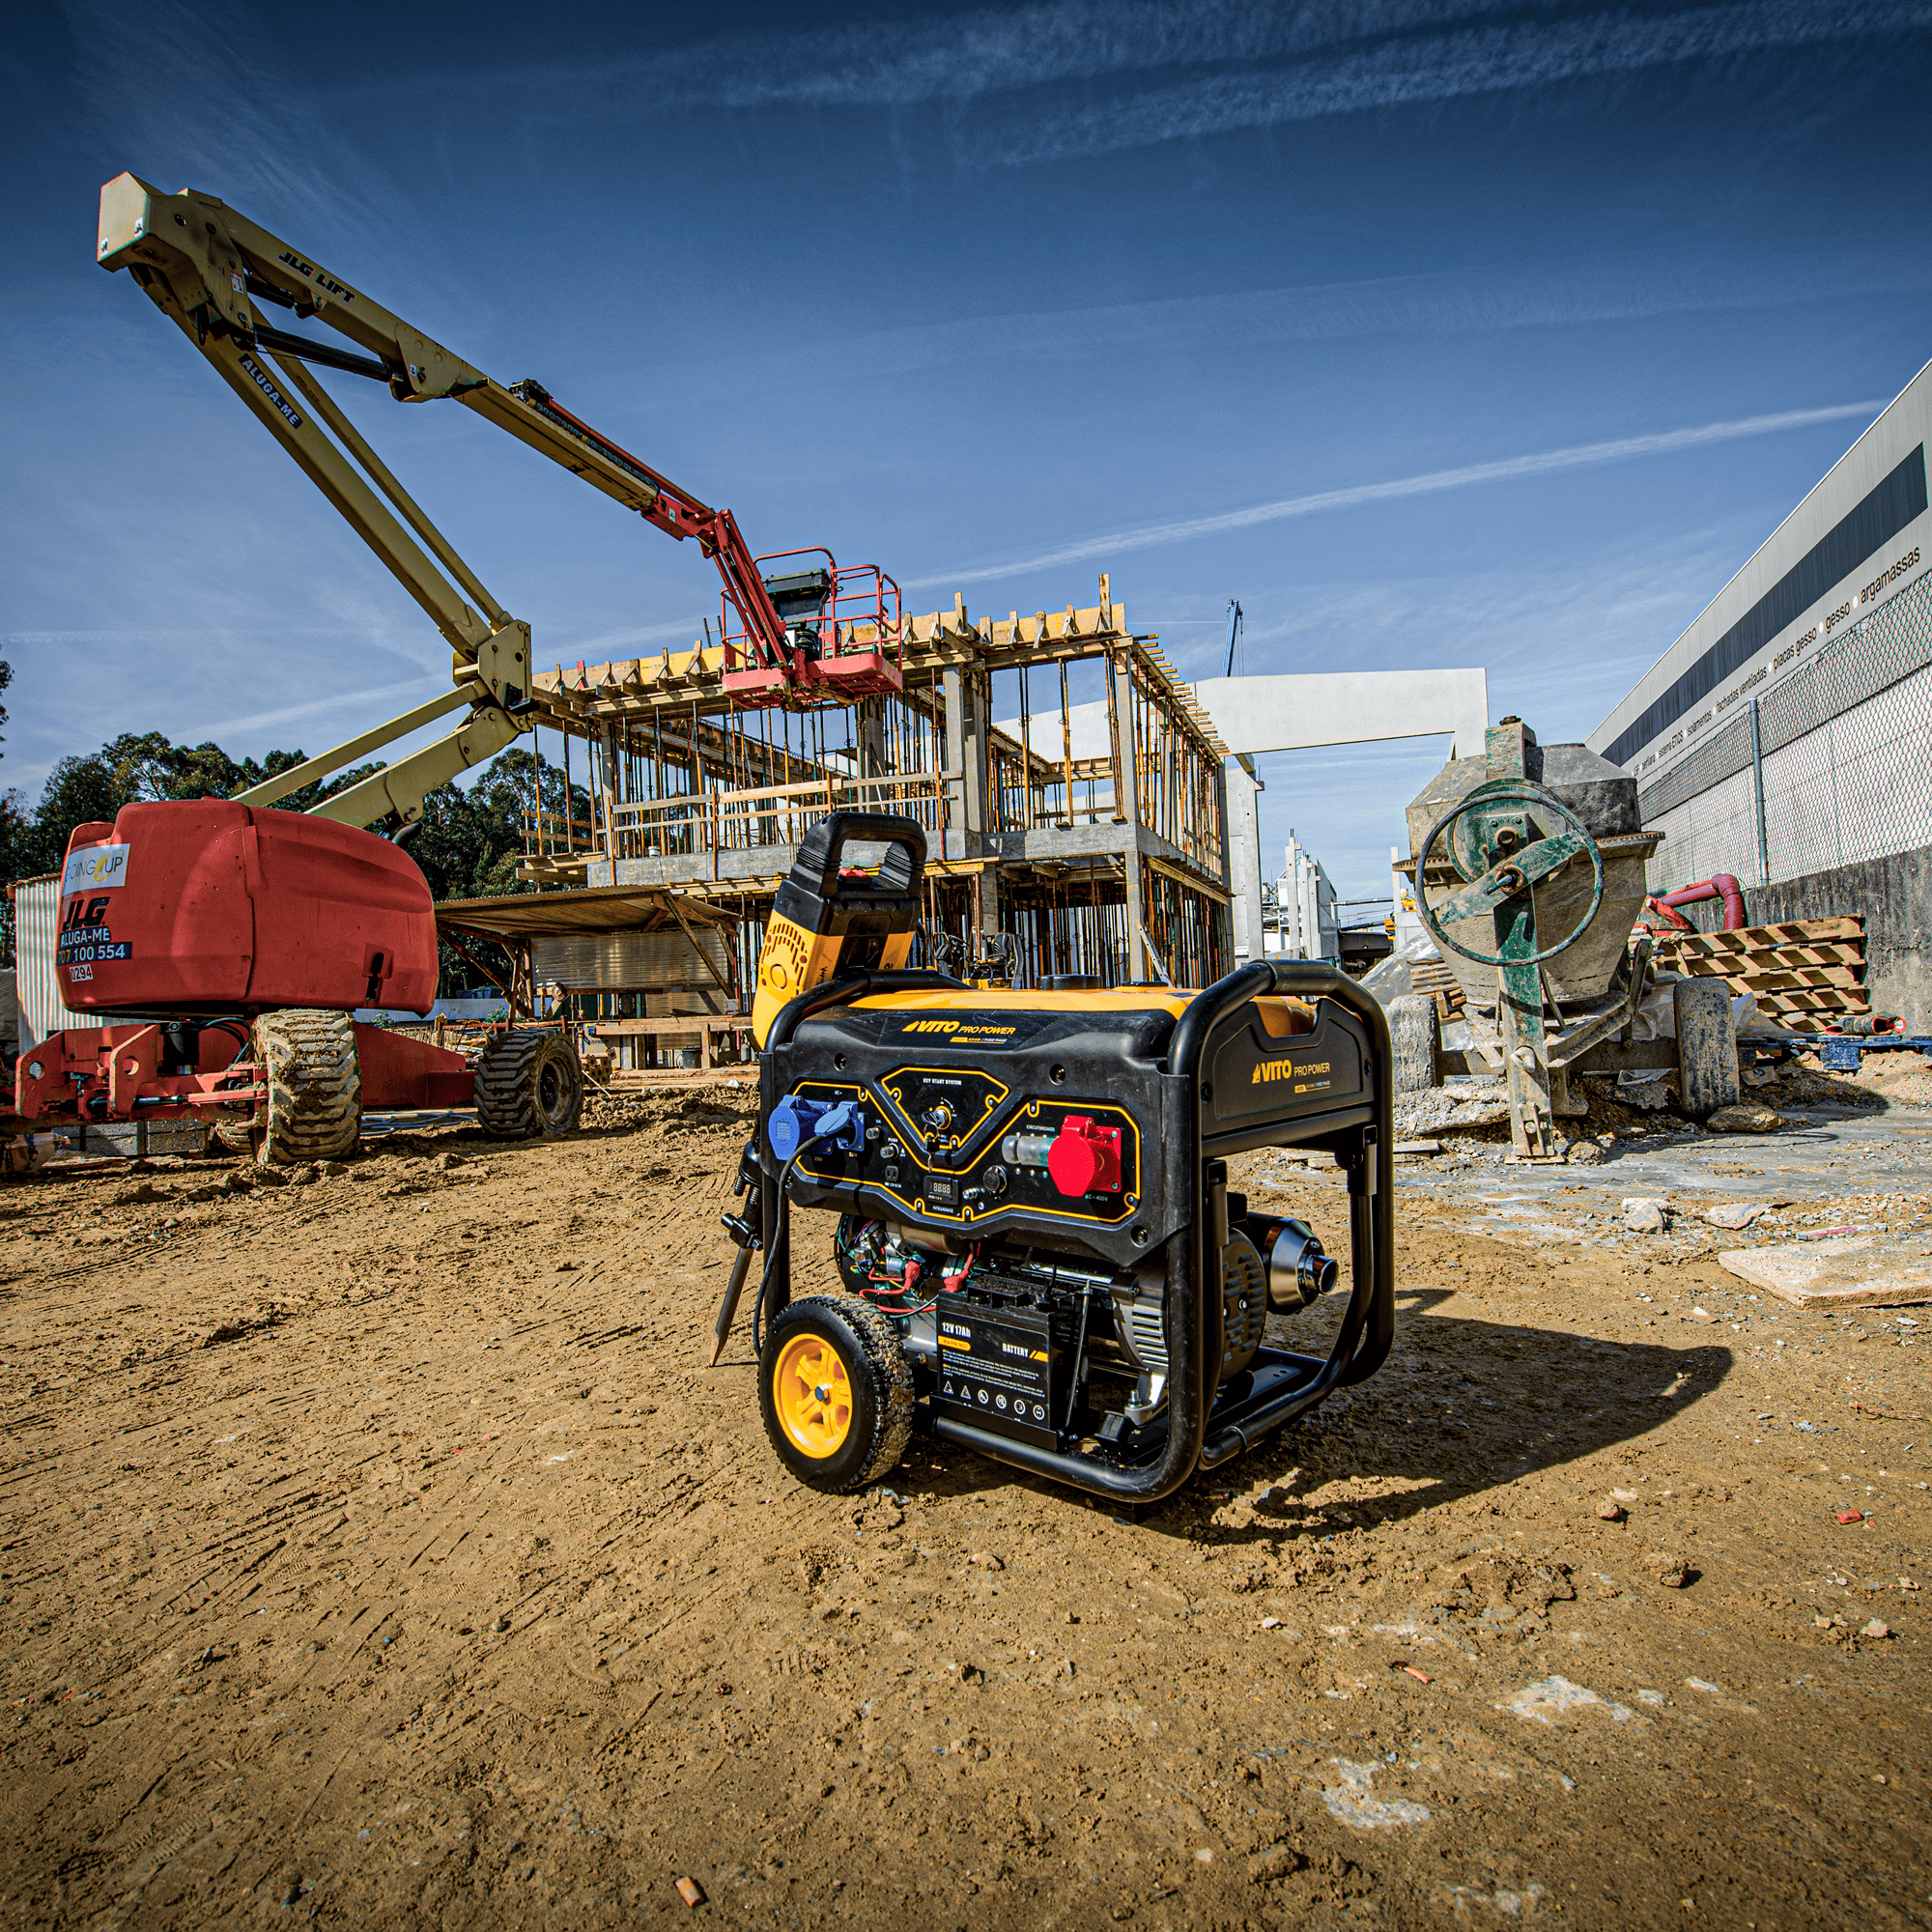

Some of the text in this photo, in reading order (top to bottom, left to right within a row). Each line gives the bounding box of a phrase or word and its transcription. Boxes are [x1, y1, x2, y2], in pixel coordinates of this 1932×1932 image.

[277, 251, 355, 303] JLG LIFT
[242, 359, 299, 425] ALUGA-ME
[1716, 689, 1739, 714] fachadas
[1739, 667, 1767, 696] ventiladas
[1773, 645, 1795, 674] placas
[1795, 628, 1817, 657] gesso
[1825, 602, 1850, 634] gesso
[1861, 547, 1920, 604] argamassas
[104, 856, 123, 873] UP
[62, 896, 111, 931] JLG
[60, 927, 110, 949] ALUGA-ME
[73, 946, 95, 962] 100
[98, 944, 126, 960] 554
[70, 967, 93, 981] 0294
[916, 1020, 960, 1033] VITO
[979, 1026, 1016, 1035] POWER
[1261, 1059, 1330, 1082] VITO PRO POWER
[942, 1321, 971, 1339] 12V 17Ah
[1002, 1343, 1029, 1357] BATTERY
